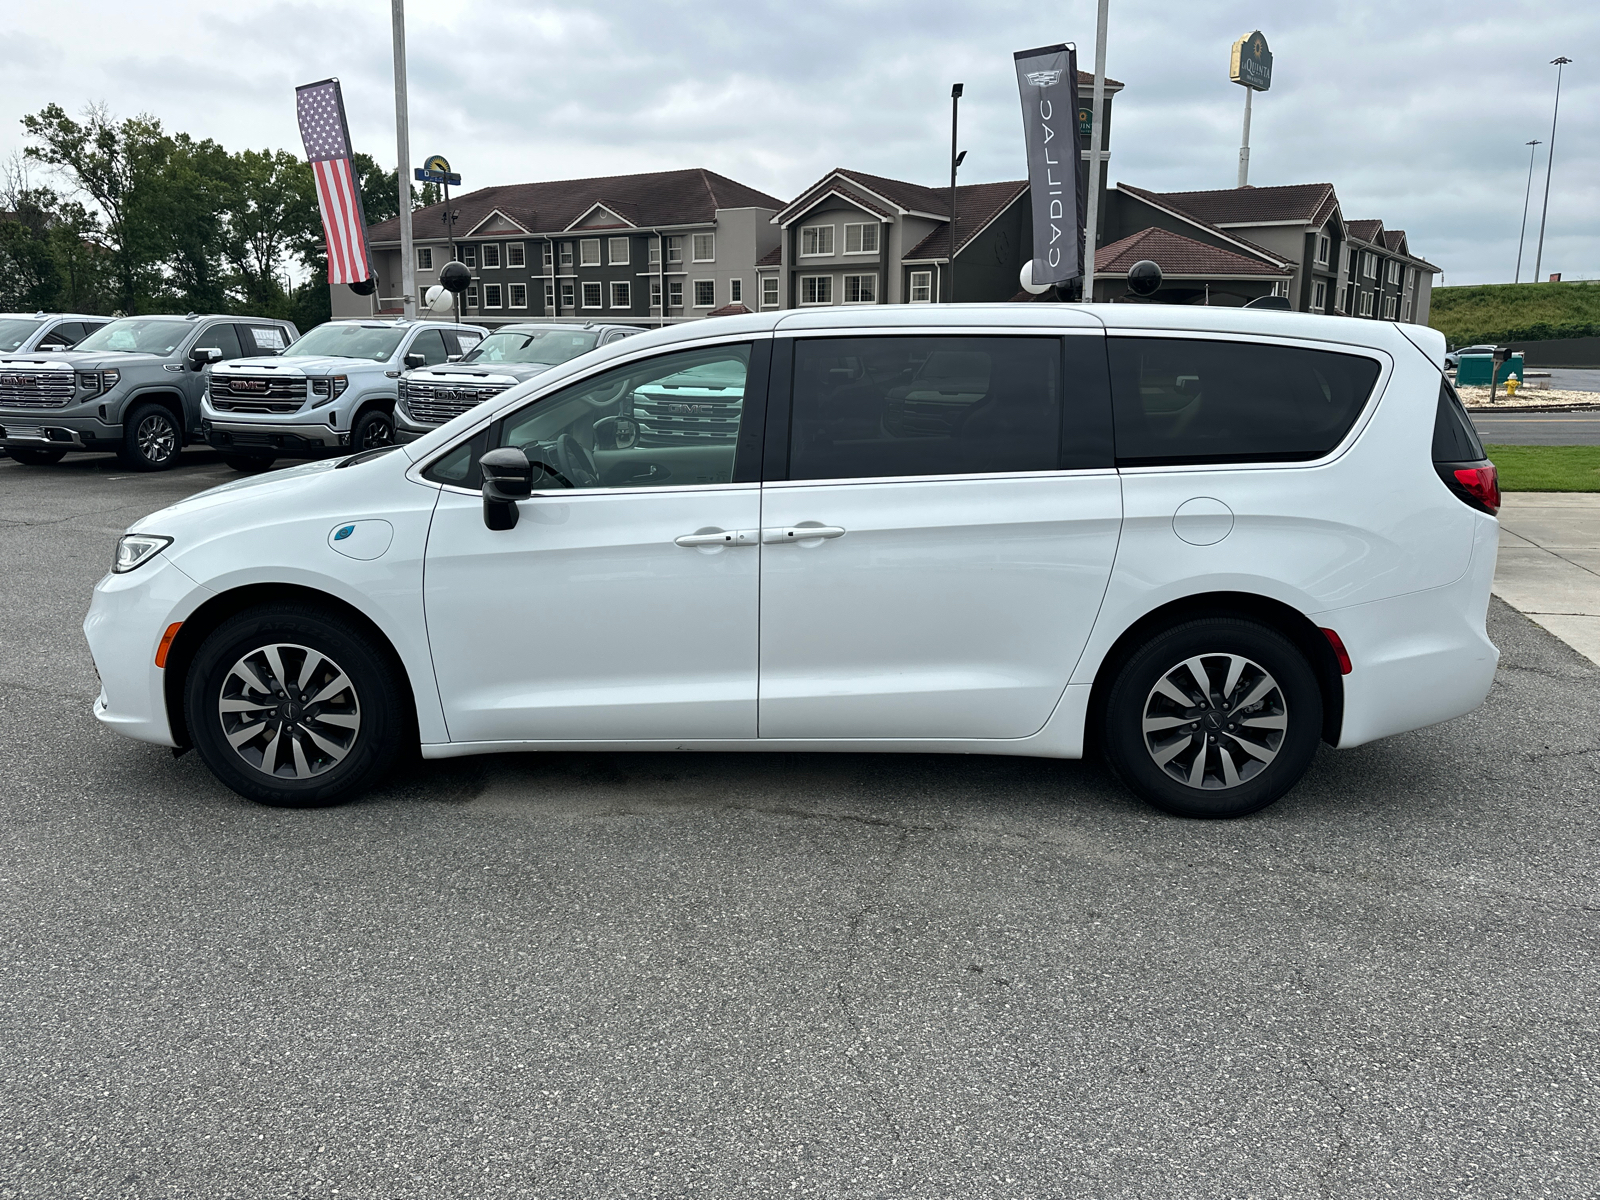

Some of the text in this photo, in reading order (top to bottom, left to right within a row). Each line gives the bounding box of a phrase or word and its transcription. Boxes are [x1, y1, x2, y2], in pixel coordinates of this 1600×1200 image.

[1246, 58, 1270, 79] QUINTA
[2, 376, 35, 386] GMC
[230, 380, 266, 390] GMC
[435, 390, 477, 401] GMC
[668, 403, 714, 414] GMC
